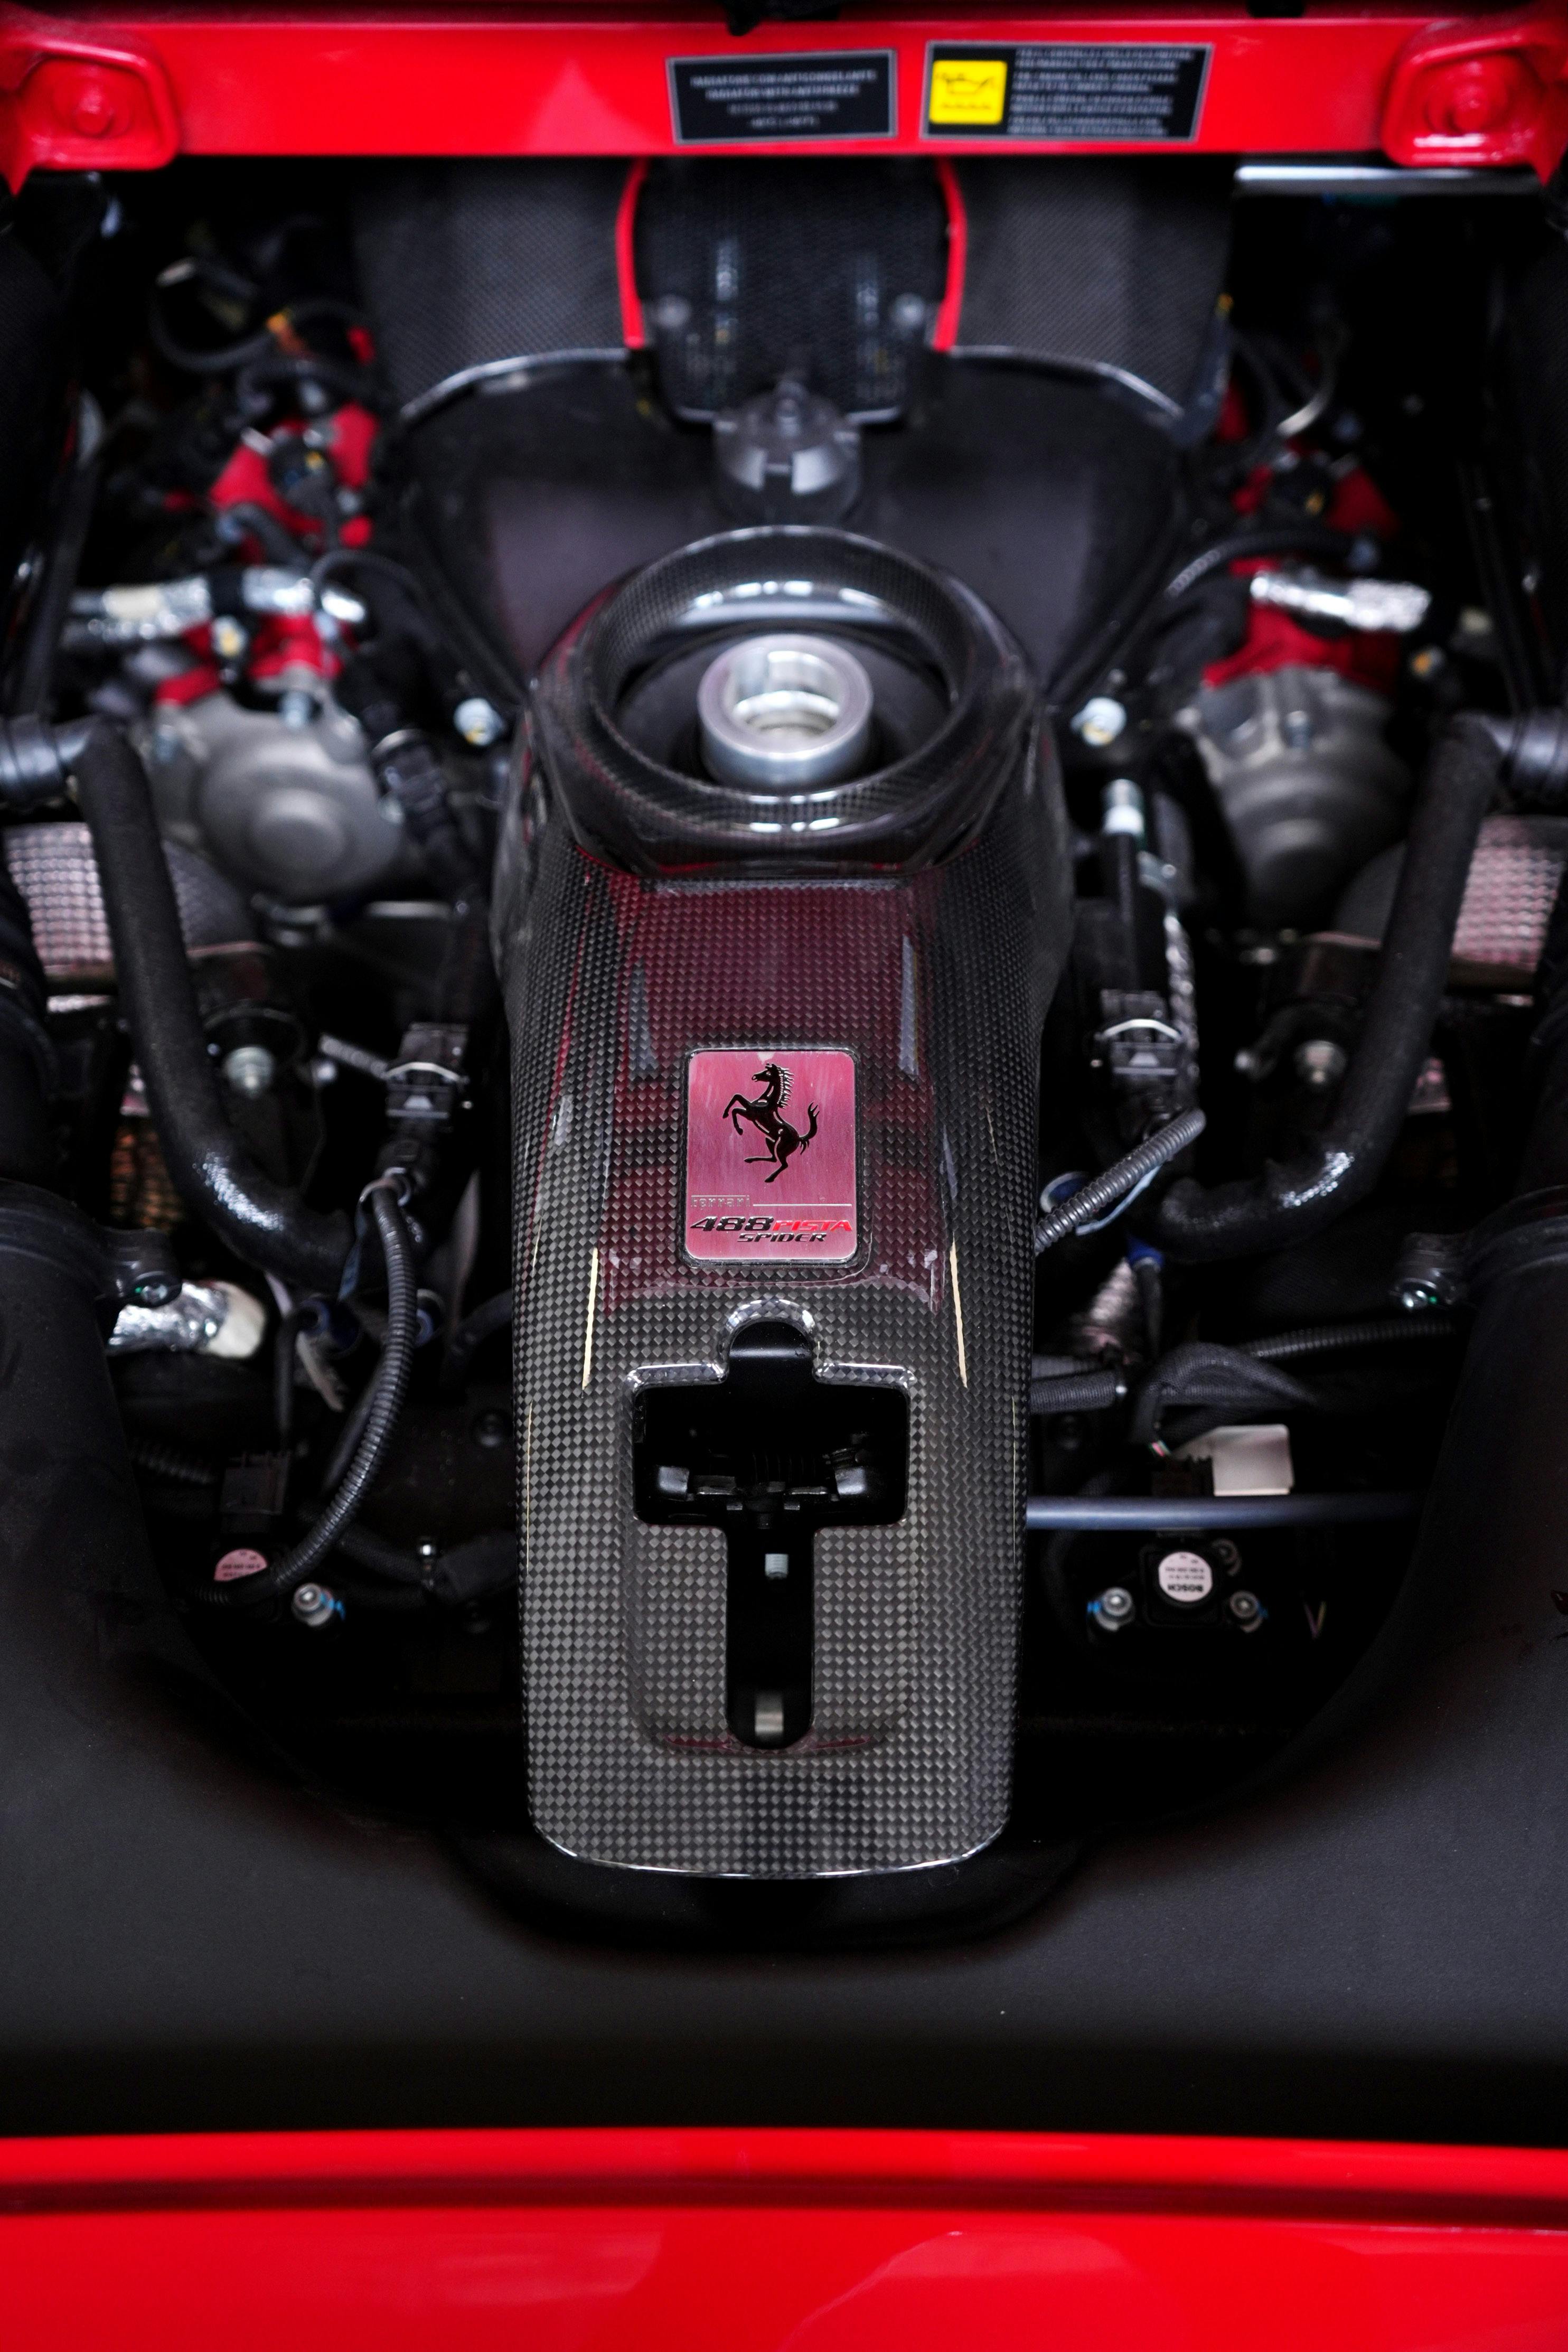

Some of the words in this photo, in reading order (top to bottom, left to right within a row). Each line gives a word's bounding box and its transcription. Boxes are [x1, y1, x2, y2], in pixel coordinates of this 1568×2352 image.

[690, 1216, 774, 1231] 488
[772, 1220, 852, 1231] PISTA
[737, 1232, 827, 1242] SPIDER
